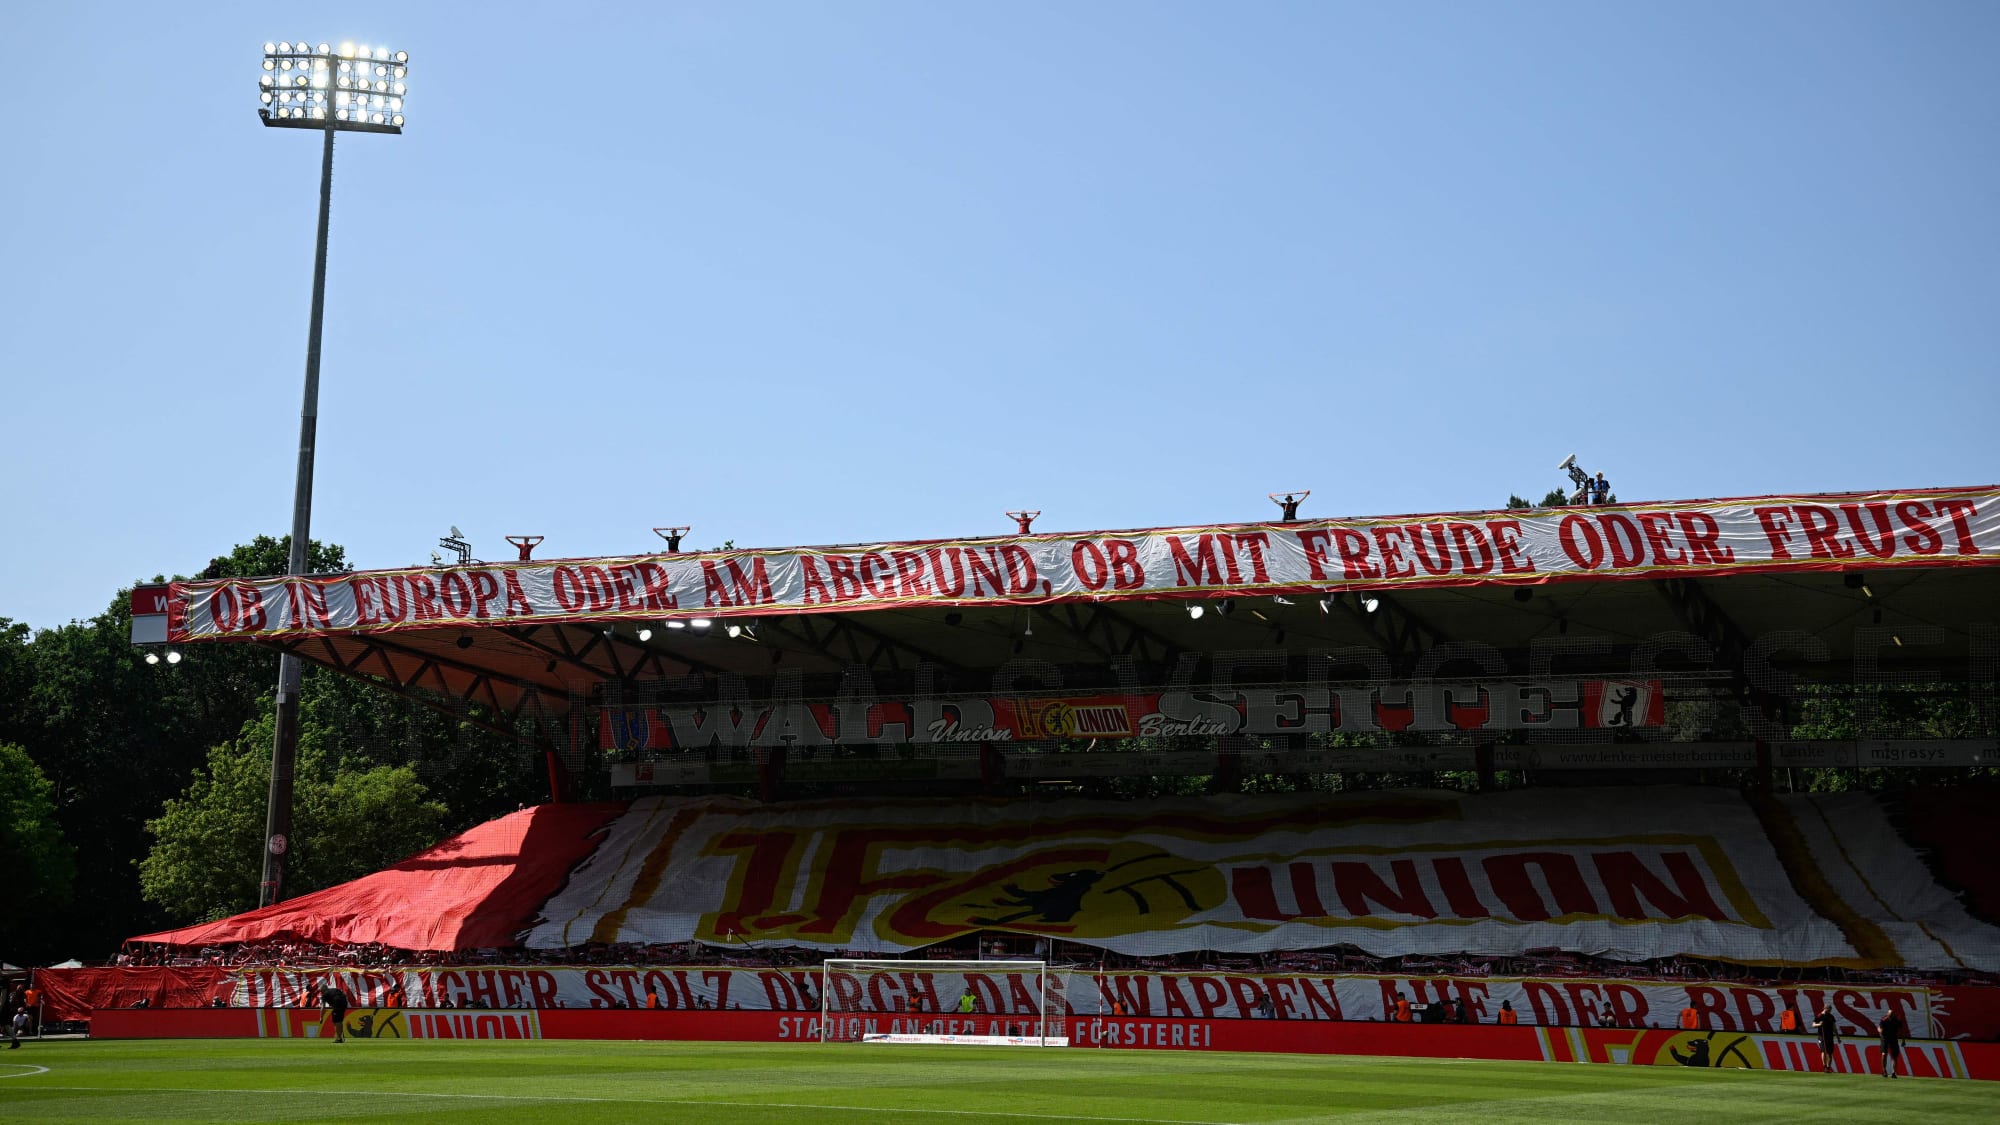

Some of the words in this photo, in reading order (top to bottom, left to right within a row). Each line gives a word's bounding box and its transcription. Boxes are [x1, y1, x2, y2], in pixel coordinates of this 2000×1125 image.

[210, 585, 267, 633] OB
[284, 580, 331, 630] IN
[350, 569, 532, 626] EUROPA
[553, 563, 678, 614] ODER
[701, 556, 775, 608] AM
[800, 544, 1052, 606] ABGRUND,
[1071, 538, 1145, 592] OB
[1165, 532, 1272, 587] MIT
[1296, 520, 1535, 581] FREUDE
[1558, 510, 1735, 571] ODER
[1754, 499, 1981, 560] FRUST
[927, 717, 1013, 744] Union
[1076, 709, 1129, 734] UNION
[1138, 713, 1230, 738] Berlin
[1872, 742, 1945, 760] migrasys
[1230, 850, 1728, 922] UNION
[585, 969, 739, 1010] STOLZ
[962, 972, 1074, 1015] DAS
[1093, 975, 1344, 1021] WAPPEN
[1522, 981, 1659, 1029] DER
[1684, 985, 1917, 1039] BRUST
[778, 1015, 877, 1039] STADION
[891, 1017, 920, 1035] AN
[933, 1019, 975, 1036] DER
[1077, 1016, 1210, 1047] FÖRSTEREI
